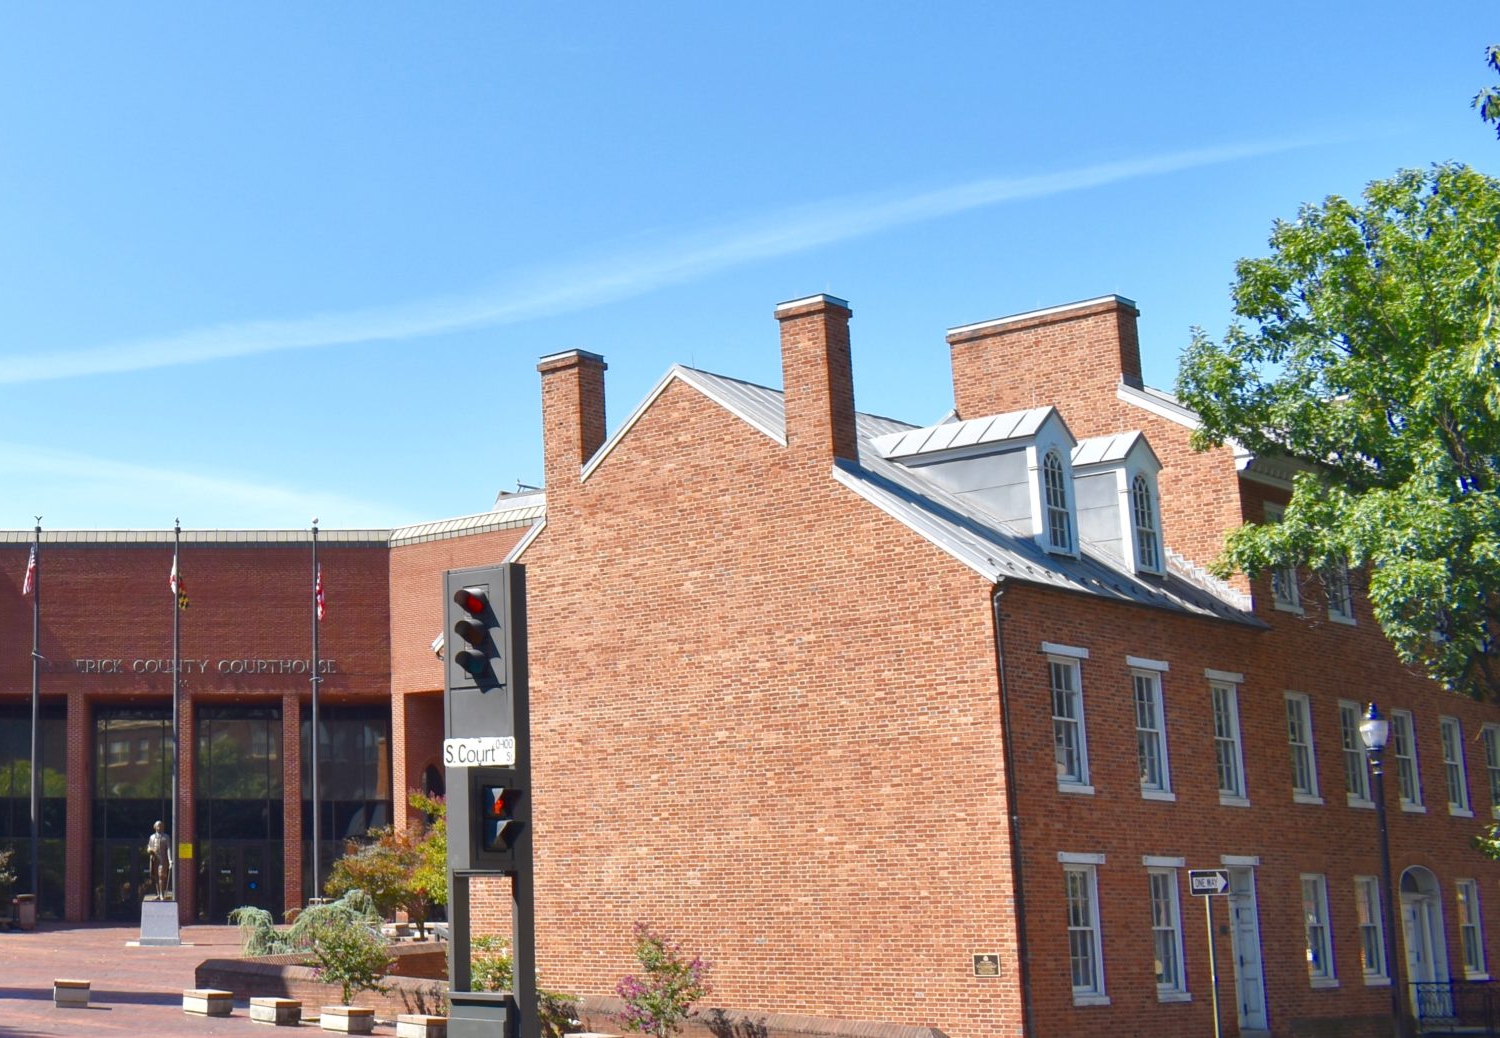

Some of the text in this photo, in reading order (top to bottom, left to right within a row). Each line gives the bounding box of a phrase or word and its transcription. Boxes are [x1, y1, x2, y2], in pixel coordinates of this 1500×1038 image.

[218, 659, 337, 674] COURTHOUSE
[446, 744, 456, 763] S.
[459, 744, 495, 763] Court
[1195, 878, 1205, 887] ONE
